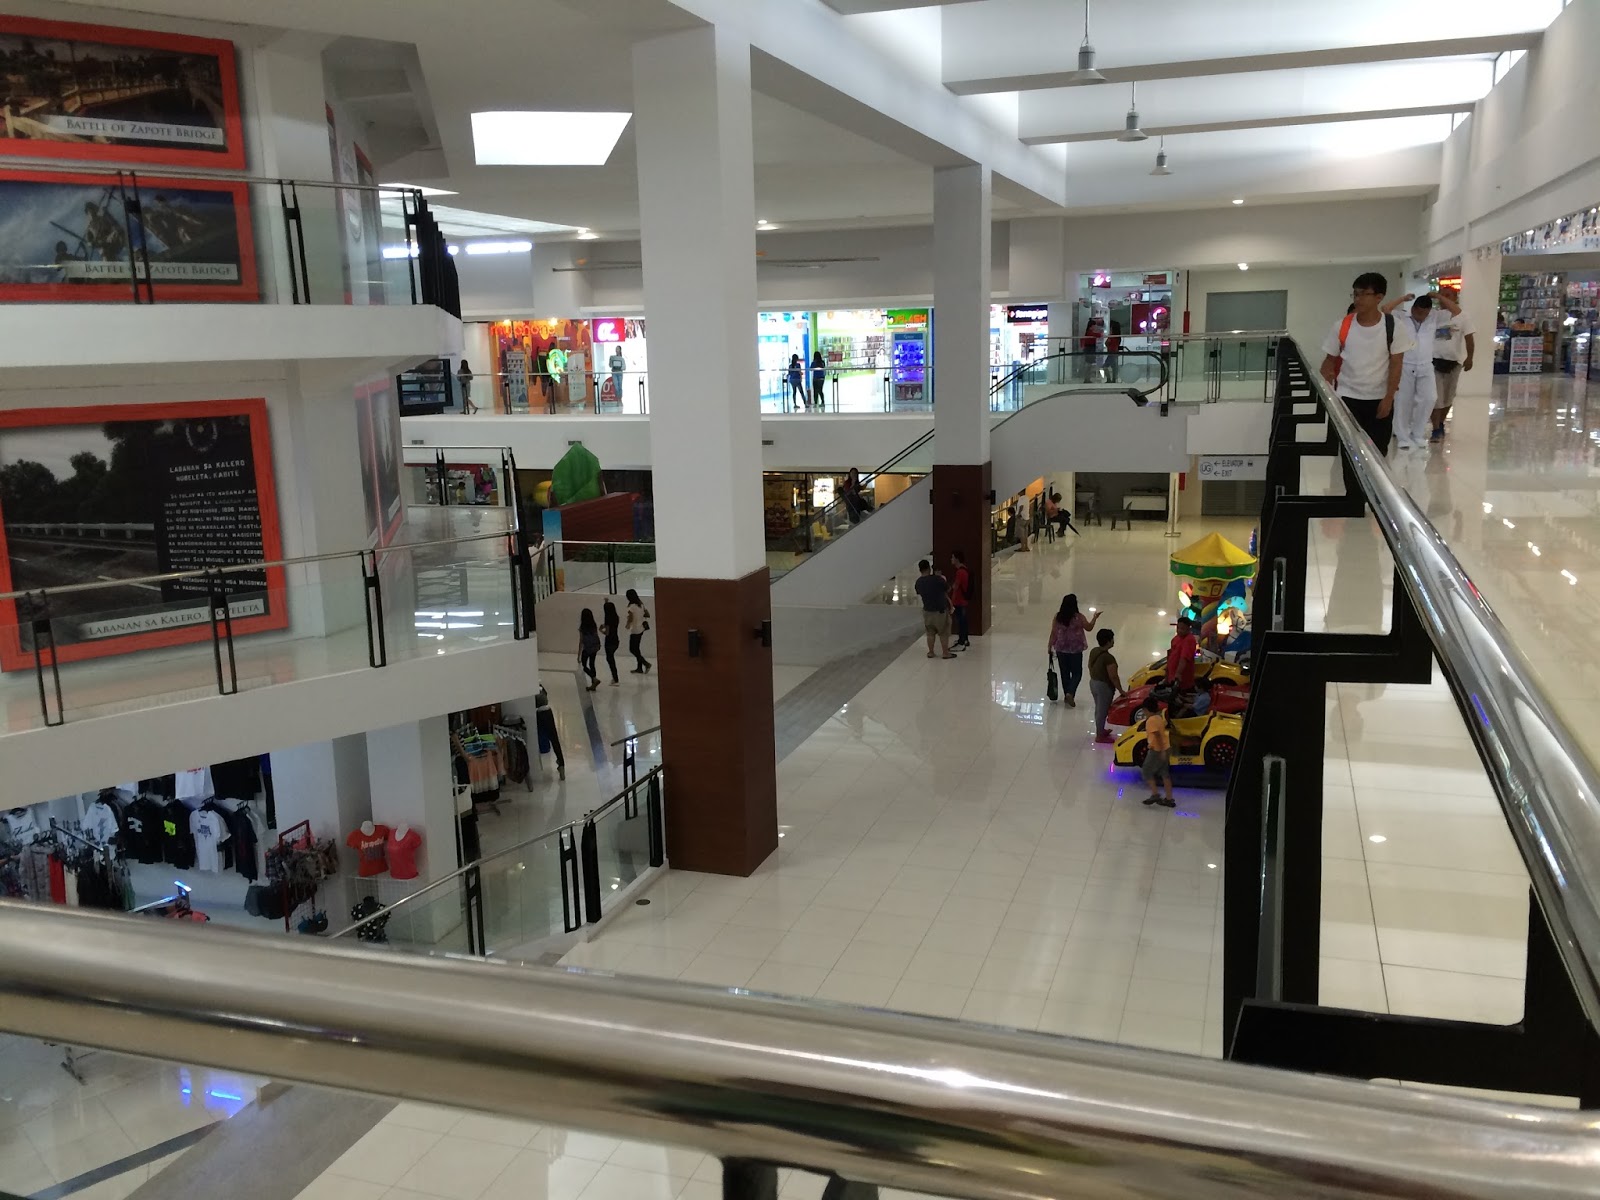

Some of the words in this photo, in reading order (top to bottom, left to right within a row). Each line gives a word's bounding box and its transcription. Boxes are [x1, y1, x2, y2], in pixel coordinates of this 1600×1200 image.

[111, 124, 125, 133] OF
[130, 123, 172, 137] ZAPOTE
[176, 127, 216, 140] BRIDGE
[128, 265, 142, 274] F
[191, 264, 230, 276] BRIDGE
[216, 460, 246, 468] KALERO
[1201, 464, 1212, 472] UG
[1222, 460, 1244, 468] ELEVATOR
[89, 620, 141, 635] LABANAN
